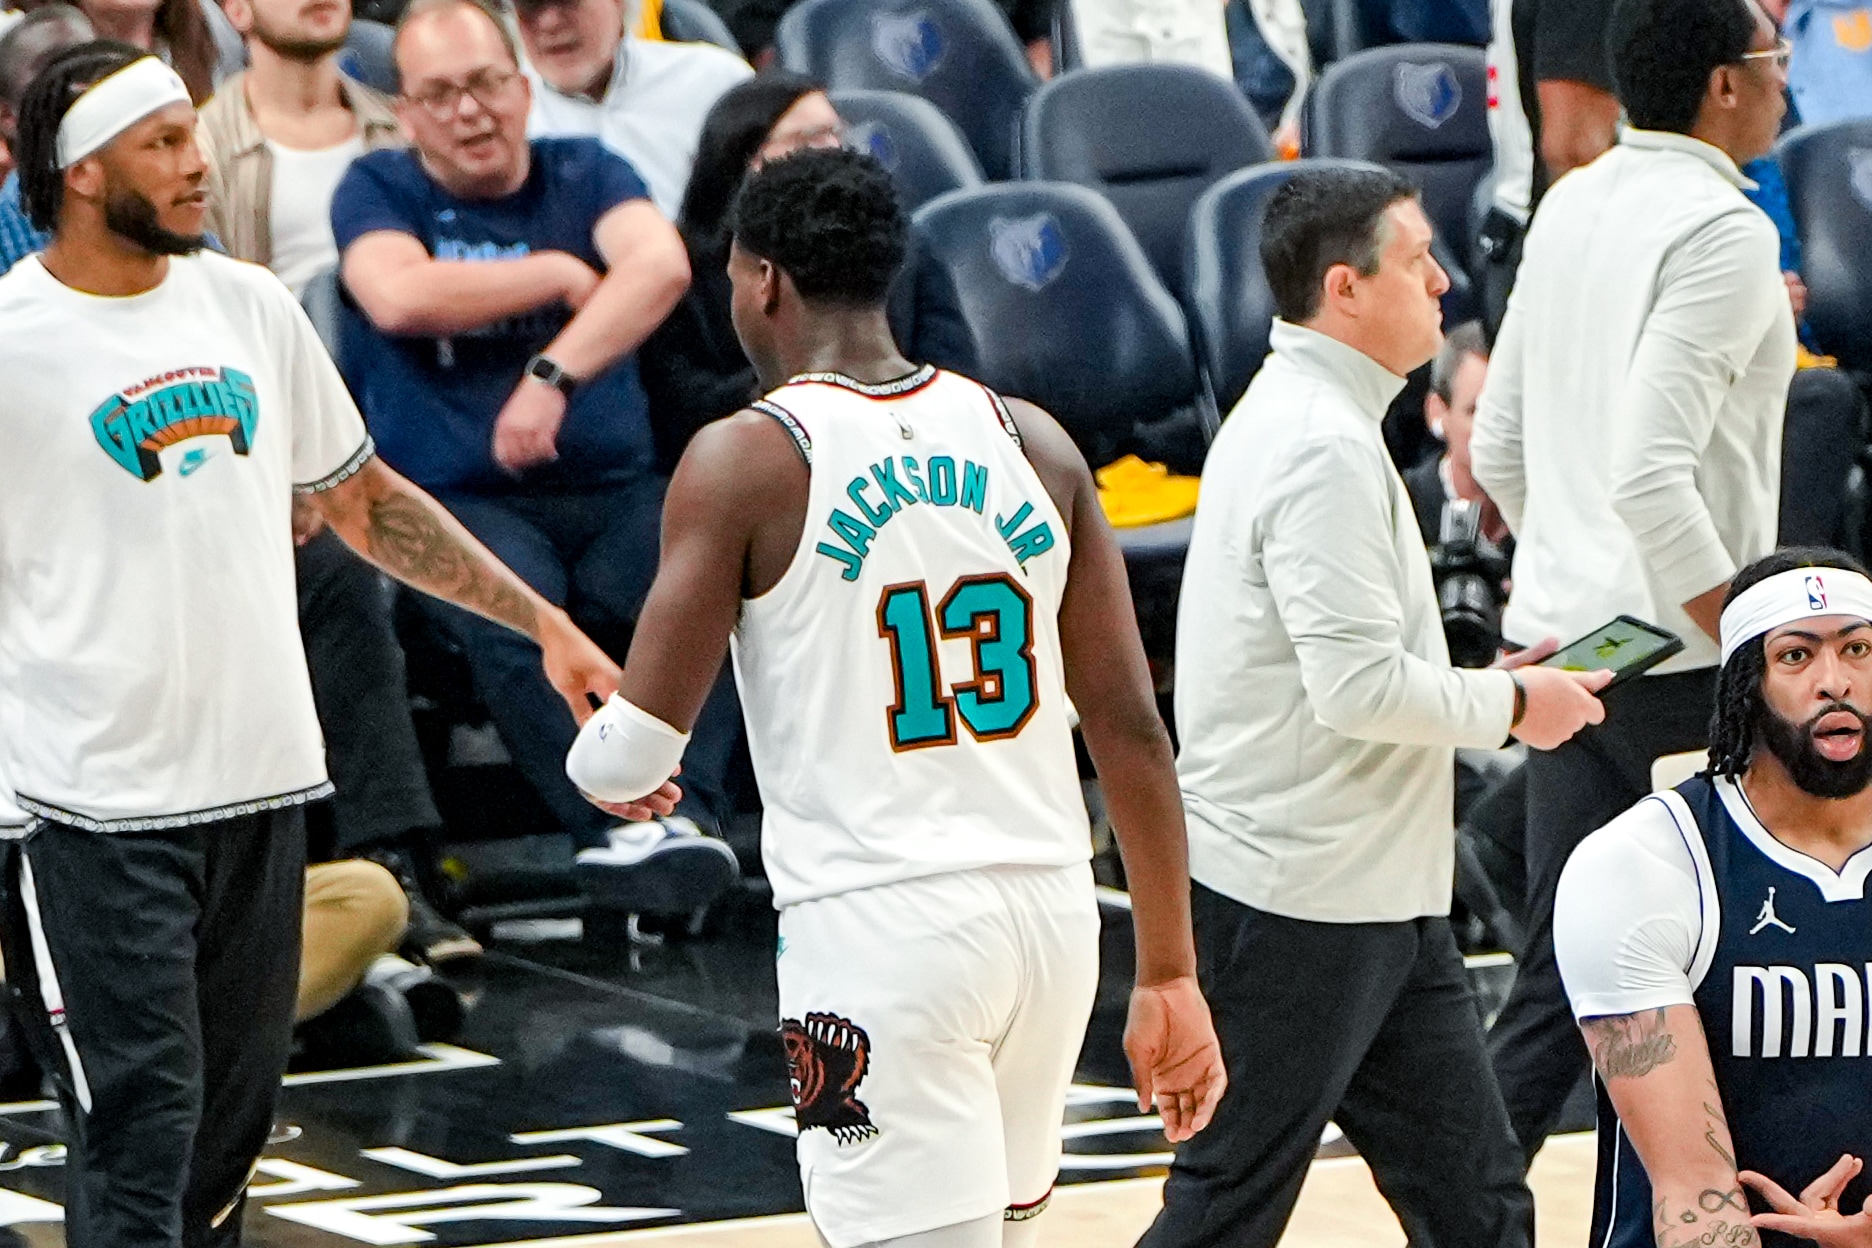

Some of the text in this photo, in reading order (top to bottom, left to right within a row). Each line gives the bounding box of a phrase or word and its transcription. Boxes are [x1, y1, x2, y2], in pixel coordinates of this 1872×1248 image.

[88, 364, 259, 481] GRIZZLIES
[815, 455, 1055, 582] JACKSON JR
[875, 571, 1040, 753] 13
